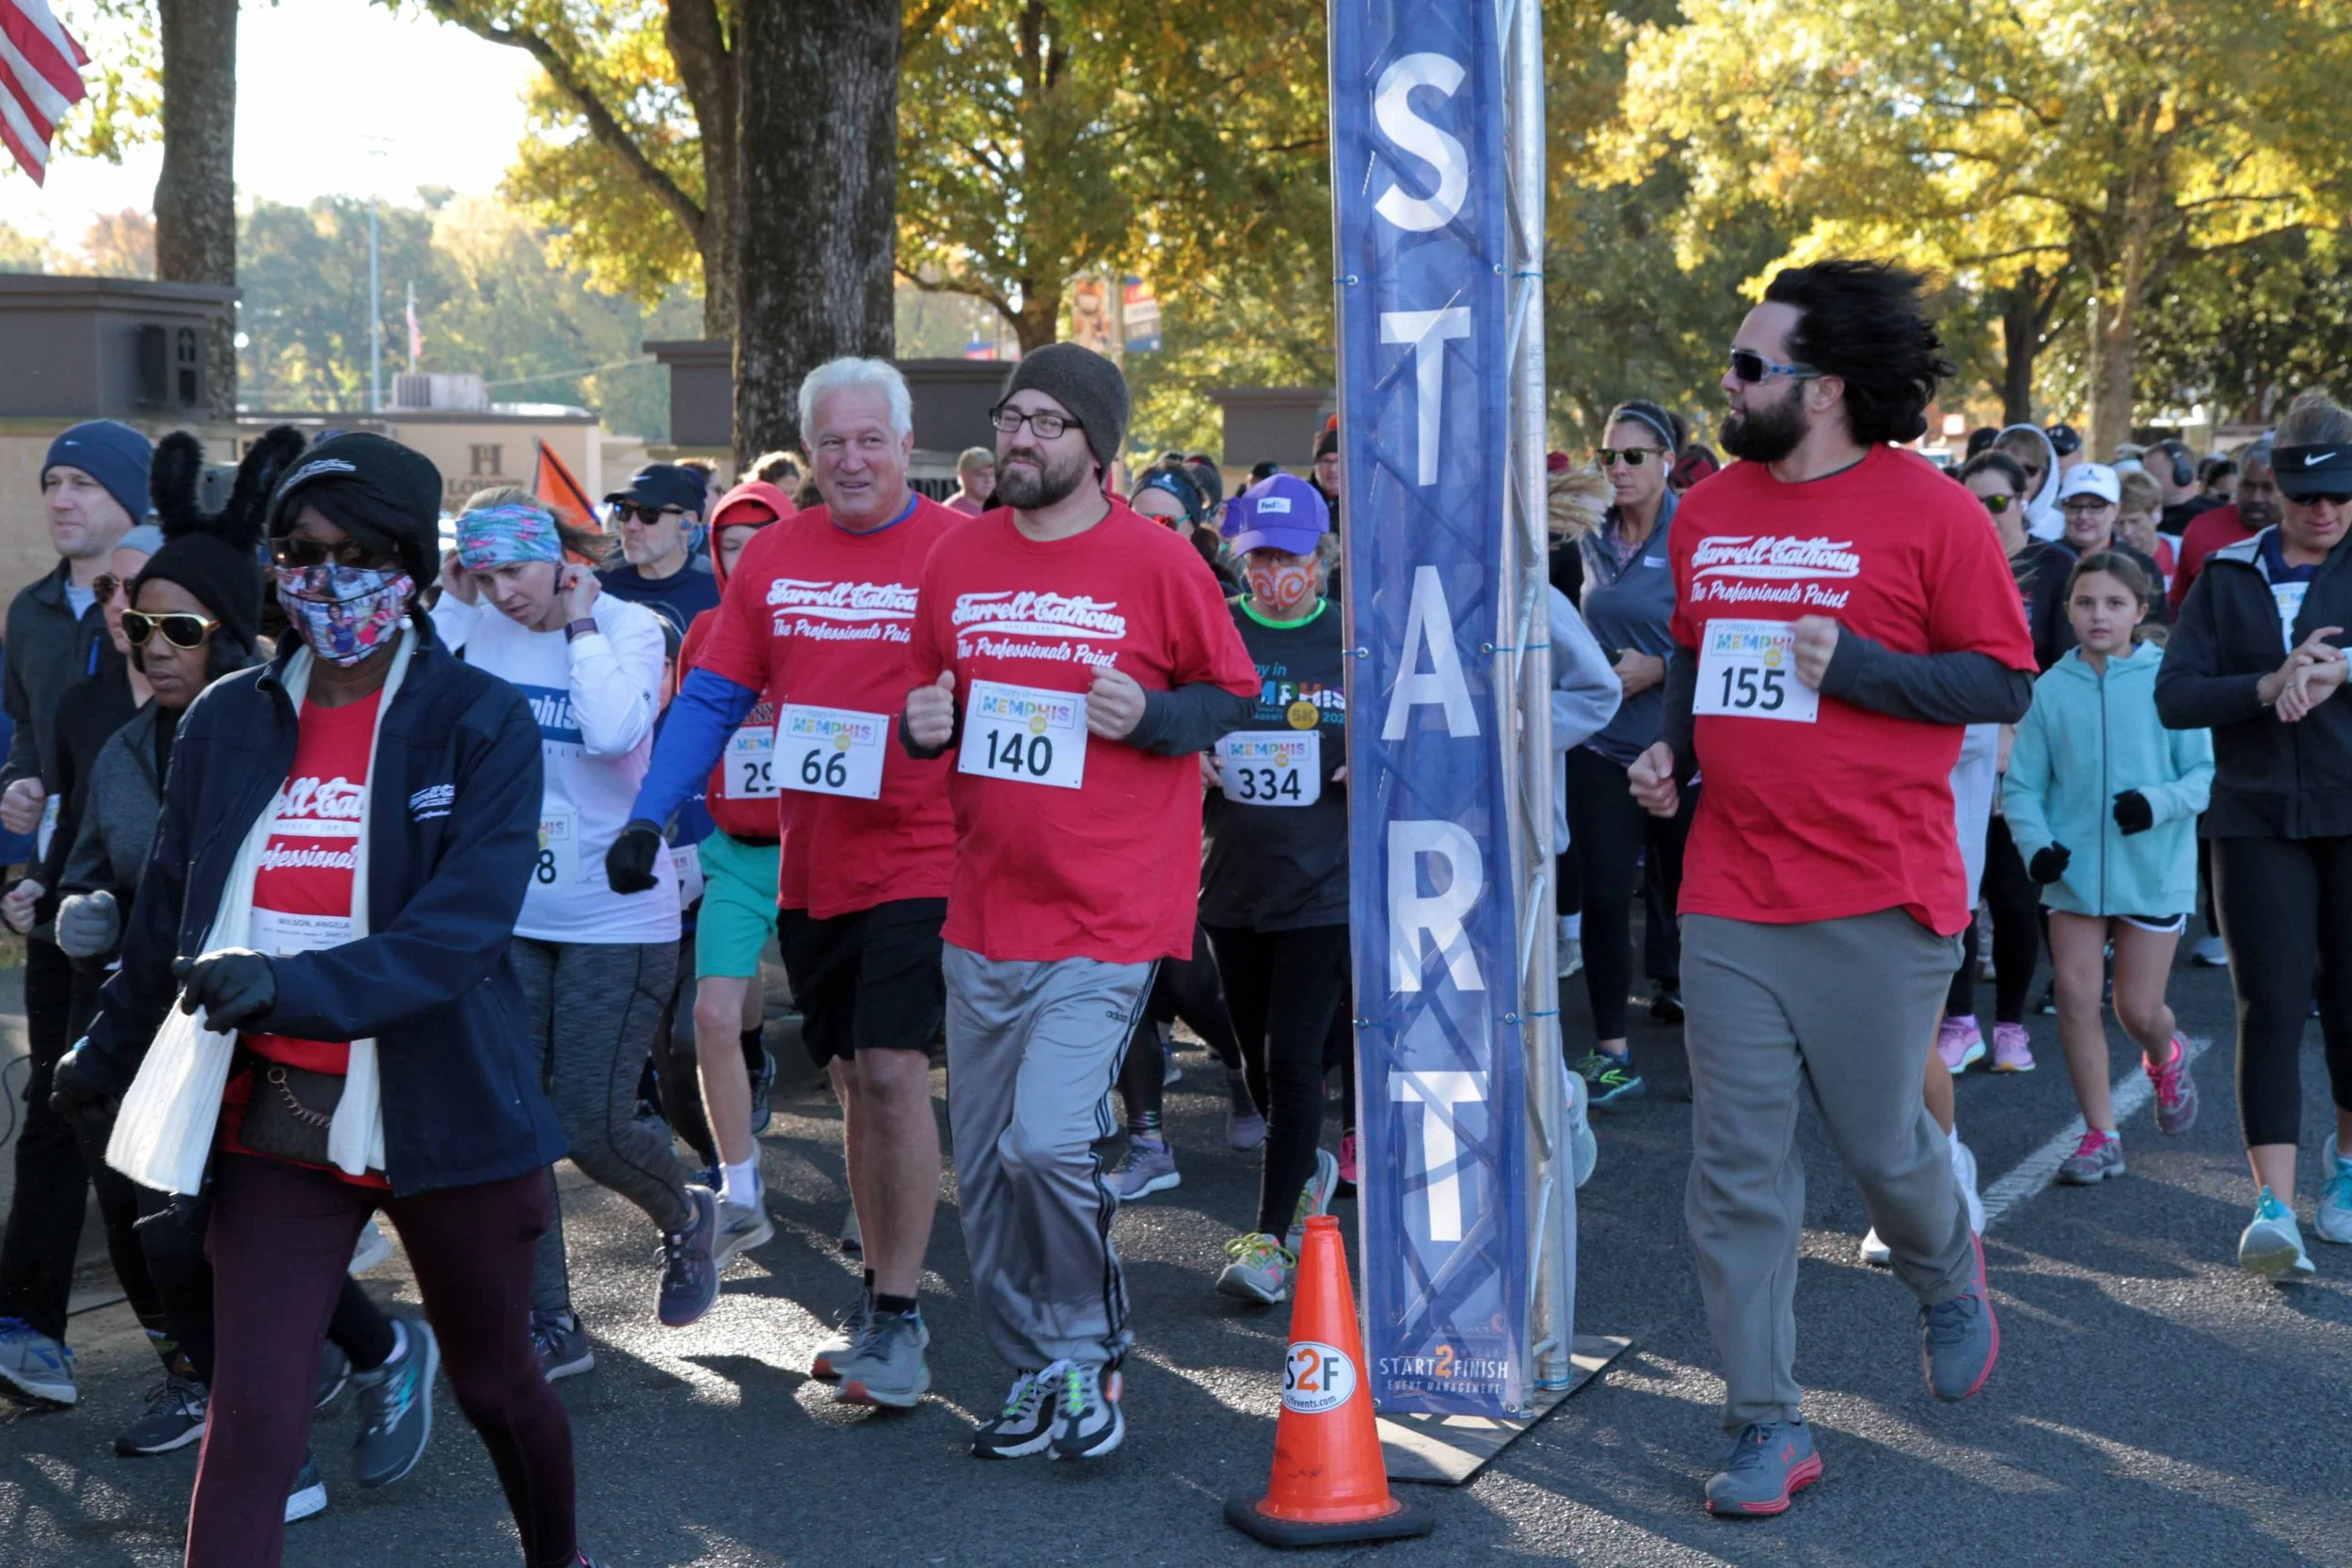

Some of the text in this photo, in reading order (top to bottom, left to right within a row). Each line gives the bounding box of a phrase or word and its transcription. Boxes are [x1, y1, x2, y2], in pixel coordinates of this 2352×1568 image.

[1691, 580, 1850, 609] The Professionals Paint
[773, 619, 791, 637] The
[794, 620, 881, 641] Professionals
[957, 637, 1118, 668] The Professionals Paint
[1375, 52, 1489, 1242] START
[1273, 662, 1287, 676] in
[1721, 666, 1785, 711] 155
[981, 695, 1070, 722] MEMPHIS
[1293, 710, 1314, 723] 5K
[792, 717, 872, 739] MEMPHIS
[986, 729, 1053, 777] 140
[1230, 743, 1306, 756] MEMPHIS
[802, 749, 846, 788] 66
[1238, 768, 1301, 800] 334
[1285, 1348, 1340, 1394] S2F
[1388, 1380, 1500, 1395] EVENT MANAGEMENT
